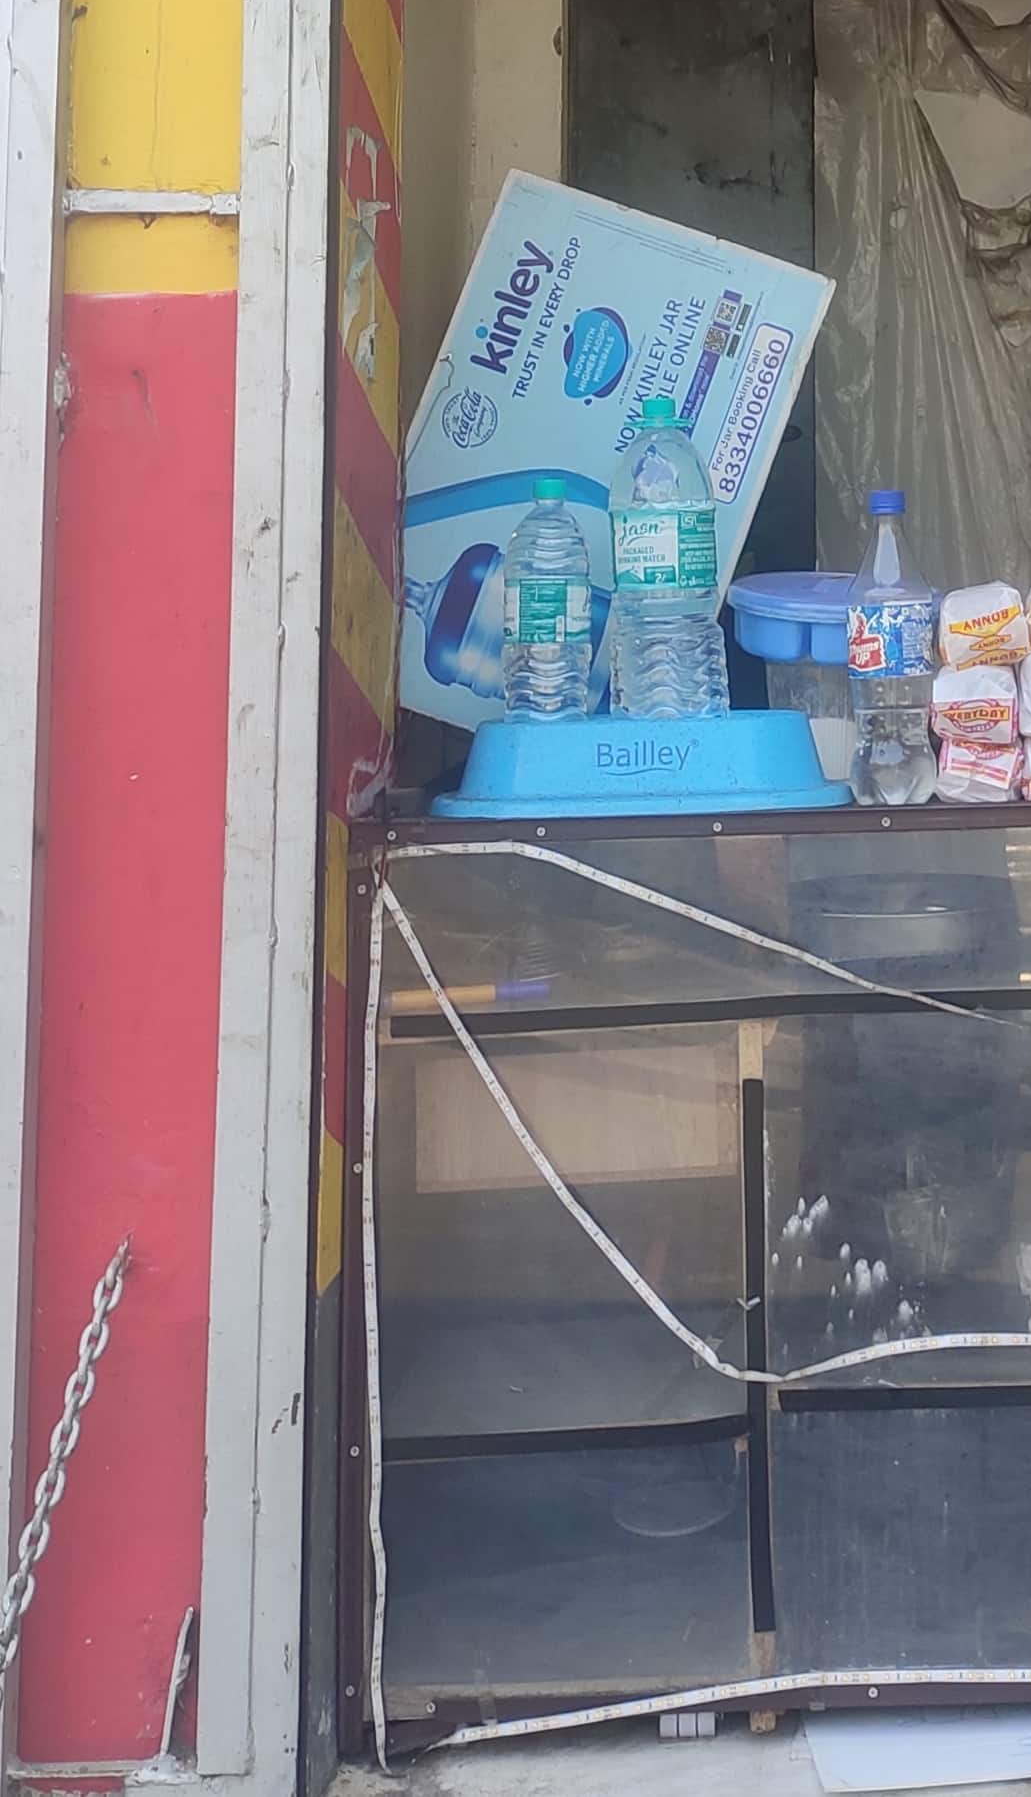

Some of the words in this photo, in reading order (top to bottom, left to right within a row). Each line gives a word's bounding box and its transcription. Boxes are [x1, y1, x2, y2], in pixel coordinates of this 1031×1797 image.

[557, 236, 582, 281] DROP
[470, 240, 554, 375] kinley
[539, 282, 565, 331] EVERY
[670, 295, 706, 366] ONLINE
[531, 331, 548, 350] IN
[512, 350, 540, 399] TRUST
[572, 353, 587, 378] NOW
[614, 407, 643, 453] NOW
[633, 336, 668, 402] KINLEY
[659, 298, 683, 335] JAR
[711, 455, 725, 472] For
[721, 431, 733, 448] Jar
[728, 376, 754, 426] Booking
[746, 349, 763, 374] Call
[718, 338, 786, 494] 8334006660
[596, 739, 691, 772] Bailley
